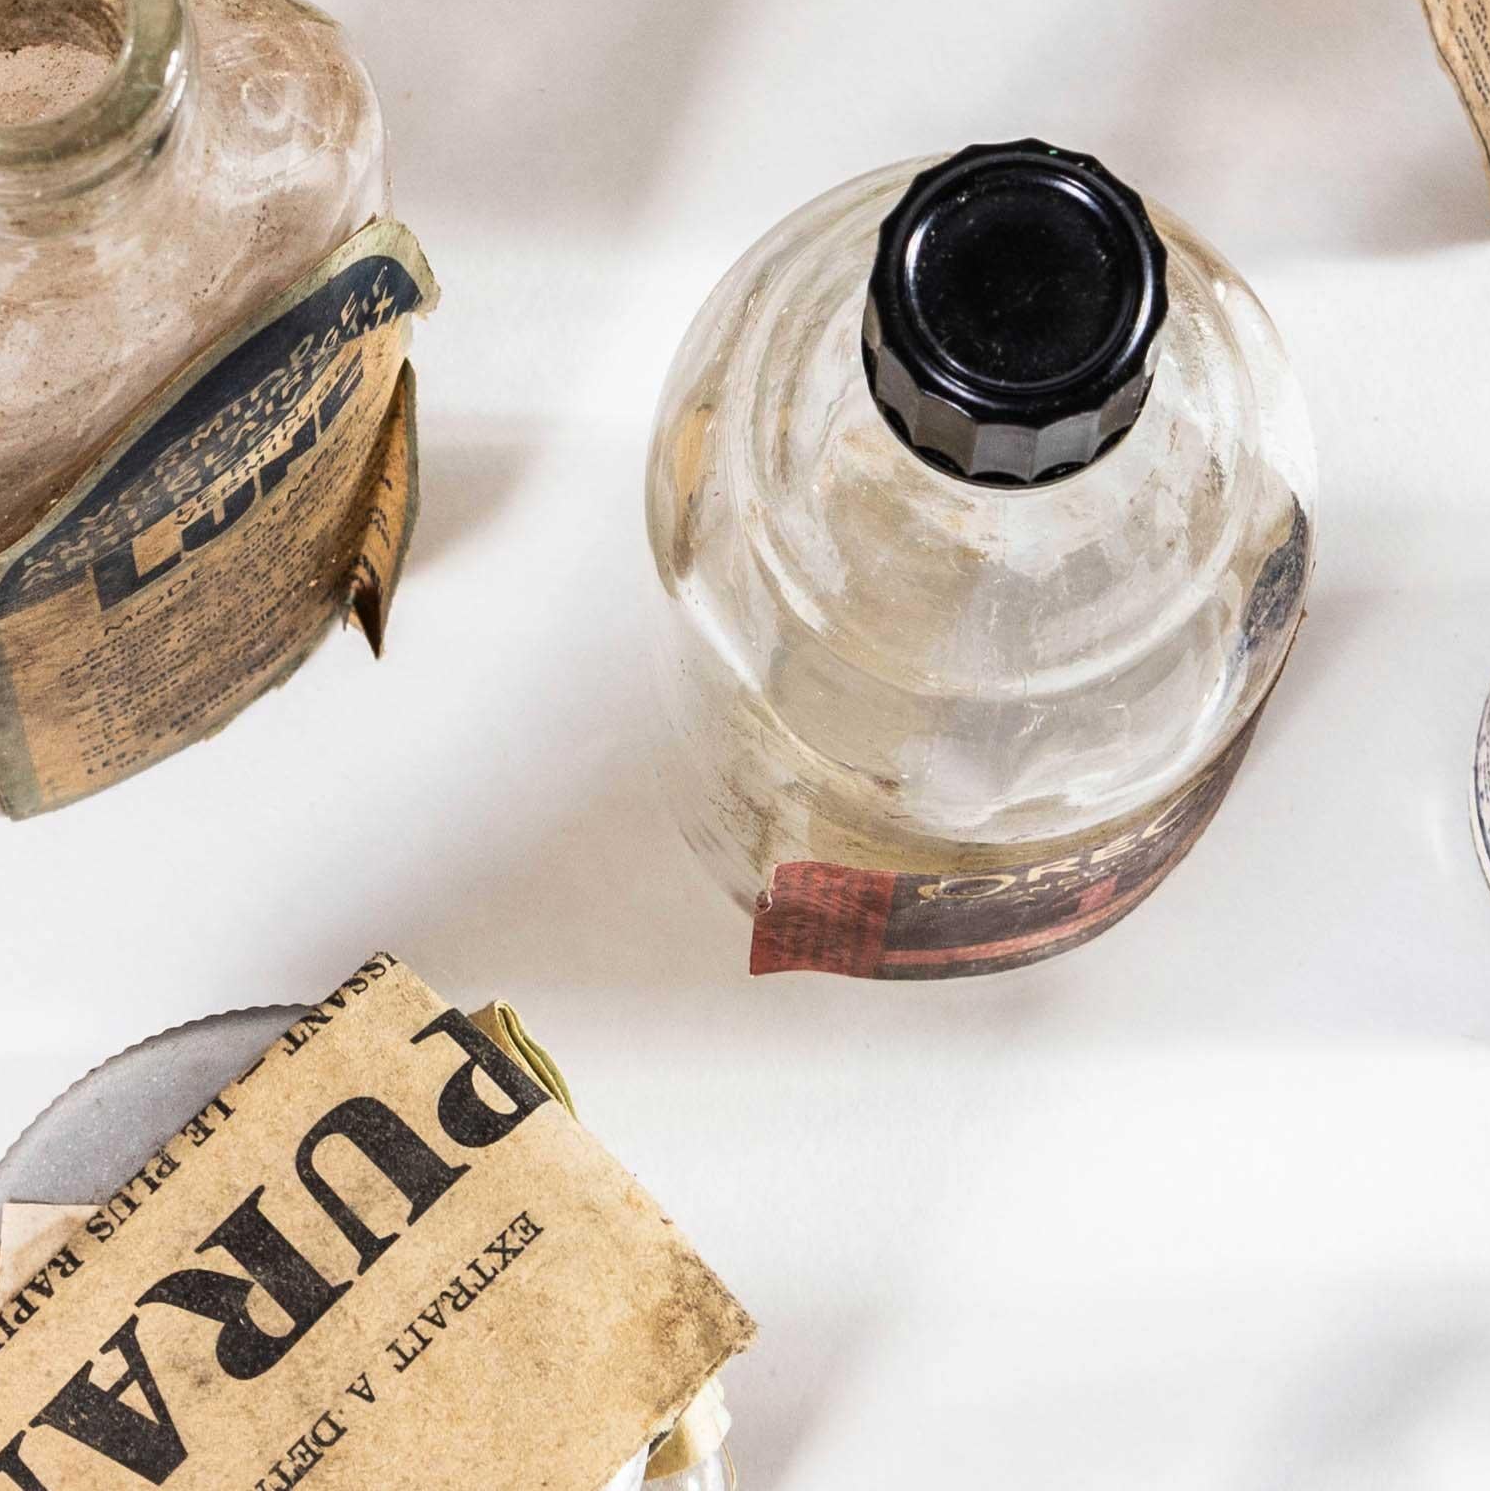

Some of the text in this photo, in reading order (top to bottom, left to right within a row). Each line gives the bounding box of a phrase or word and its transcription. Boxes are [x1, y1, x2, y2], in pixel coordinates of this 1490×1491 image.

[105, 568, 206, 636] MODE
[179, 1097, 237, 1152] LE
[84, 1145, 183, 1247] PLUS
[345, 1209, 546, 1403] EXTRAIT A
